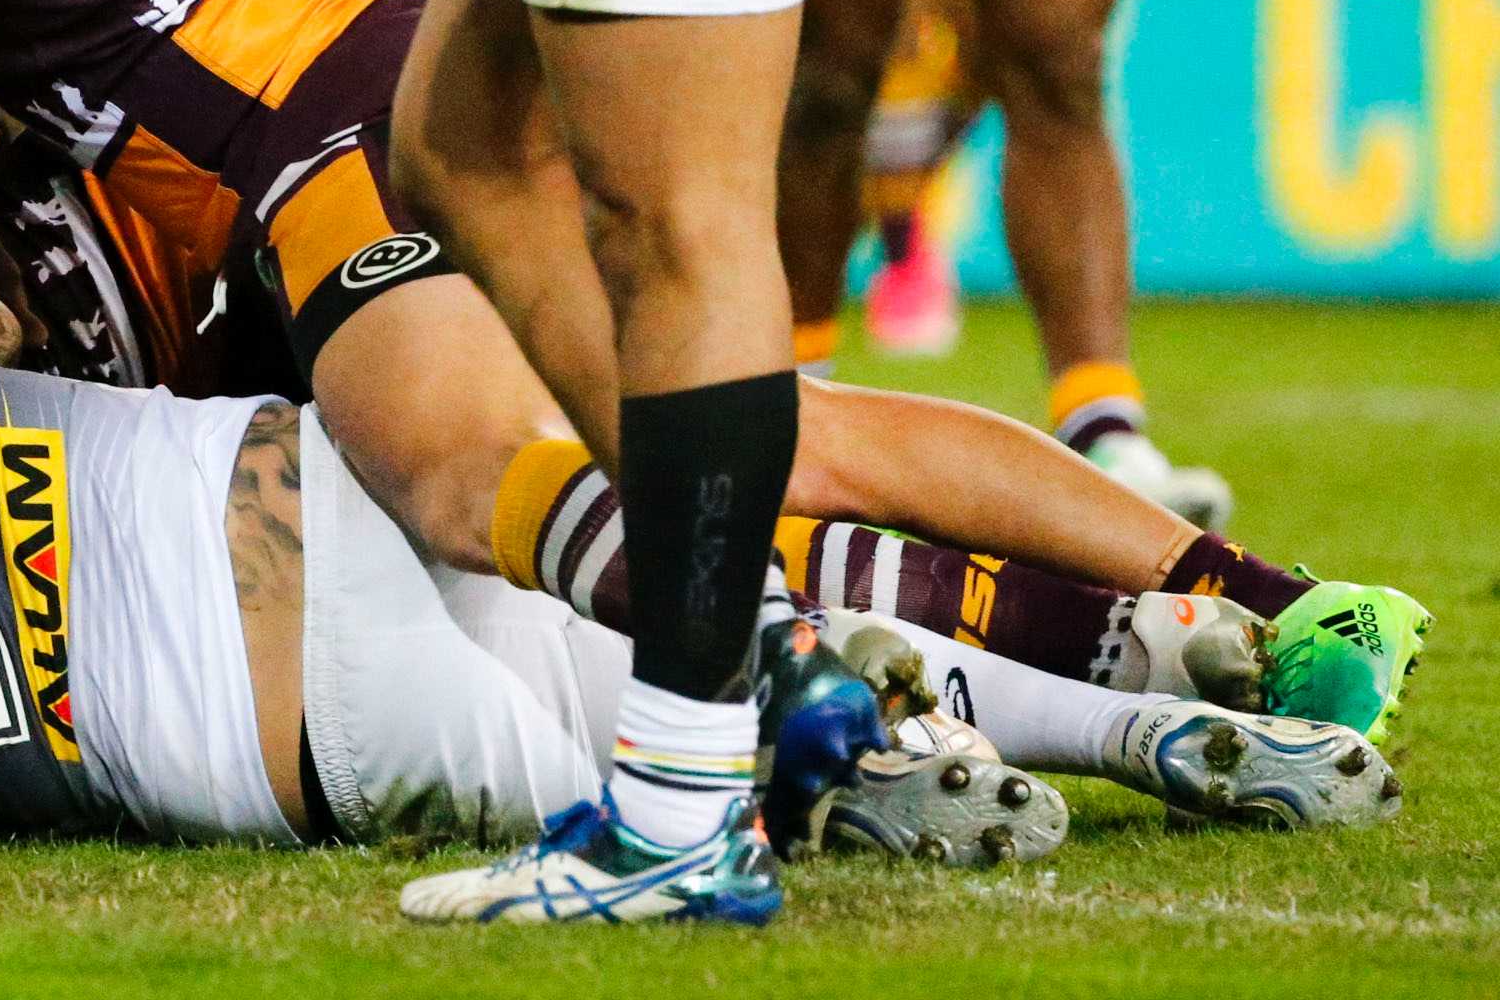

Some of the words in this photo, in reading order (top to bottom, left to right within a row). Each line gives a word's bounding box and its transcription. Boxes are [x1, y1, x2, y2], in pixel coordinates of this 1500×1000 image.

[1, 443, 77, 744] ALLAM
[1357, 602, 1384, 657] adidas
[1139, 711, 1172, 756] asics
